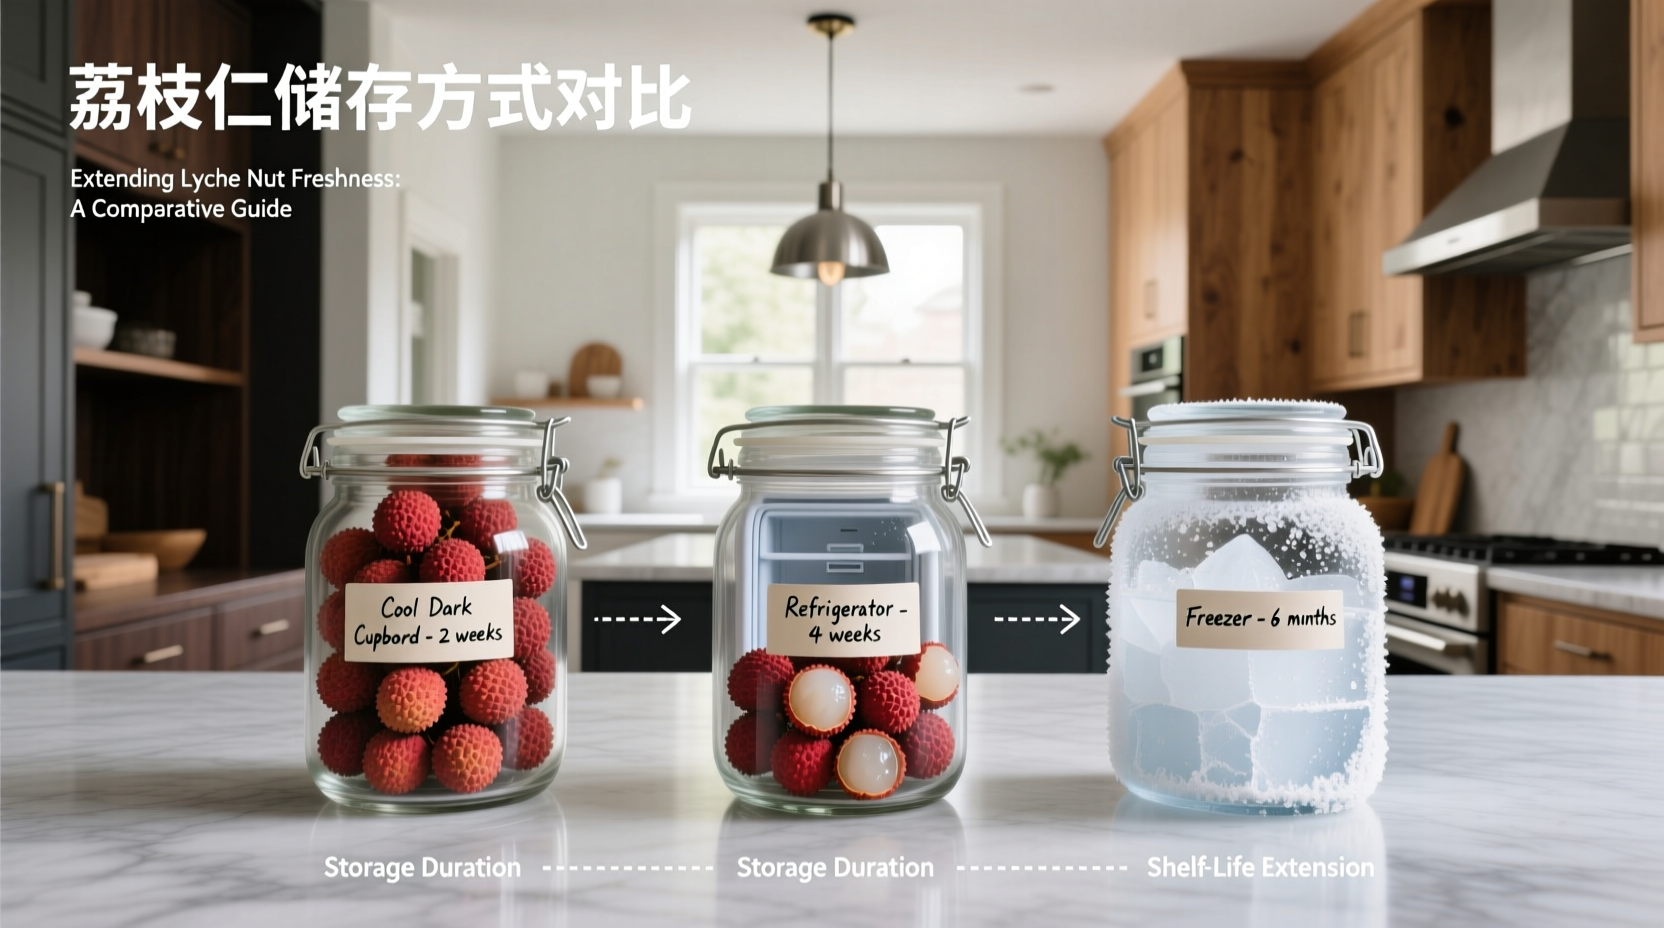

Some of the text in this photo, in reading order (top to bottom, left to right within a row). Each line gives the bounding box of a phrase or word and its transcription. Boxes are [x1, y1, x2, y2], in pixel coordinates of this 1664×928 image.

[381, 595, 472, 619] Cool Dark
[785, 595, 894, 625] Refrigerator
[1186, 605, 1252, 627] Freezer
[1271, 607, 1280, 627] 6
[354, 623, 421, 652] Cupbord
[439, 628, 450, 644] 2
[456, 622, 503, 643] weeks
[808, 623, 881, 644] 4 weeks
